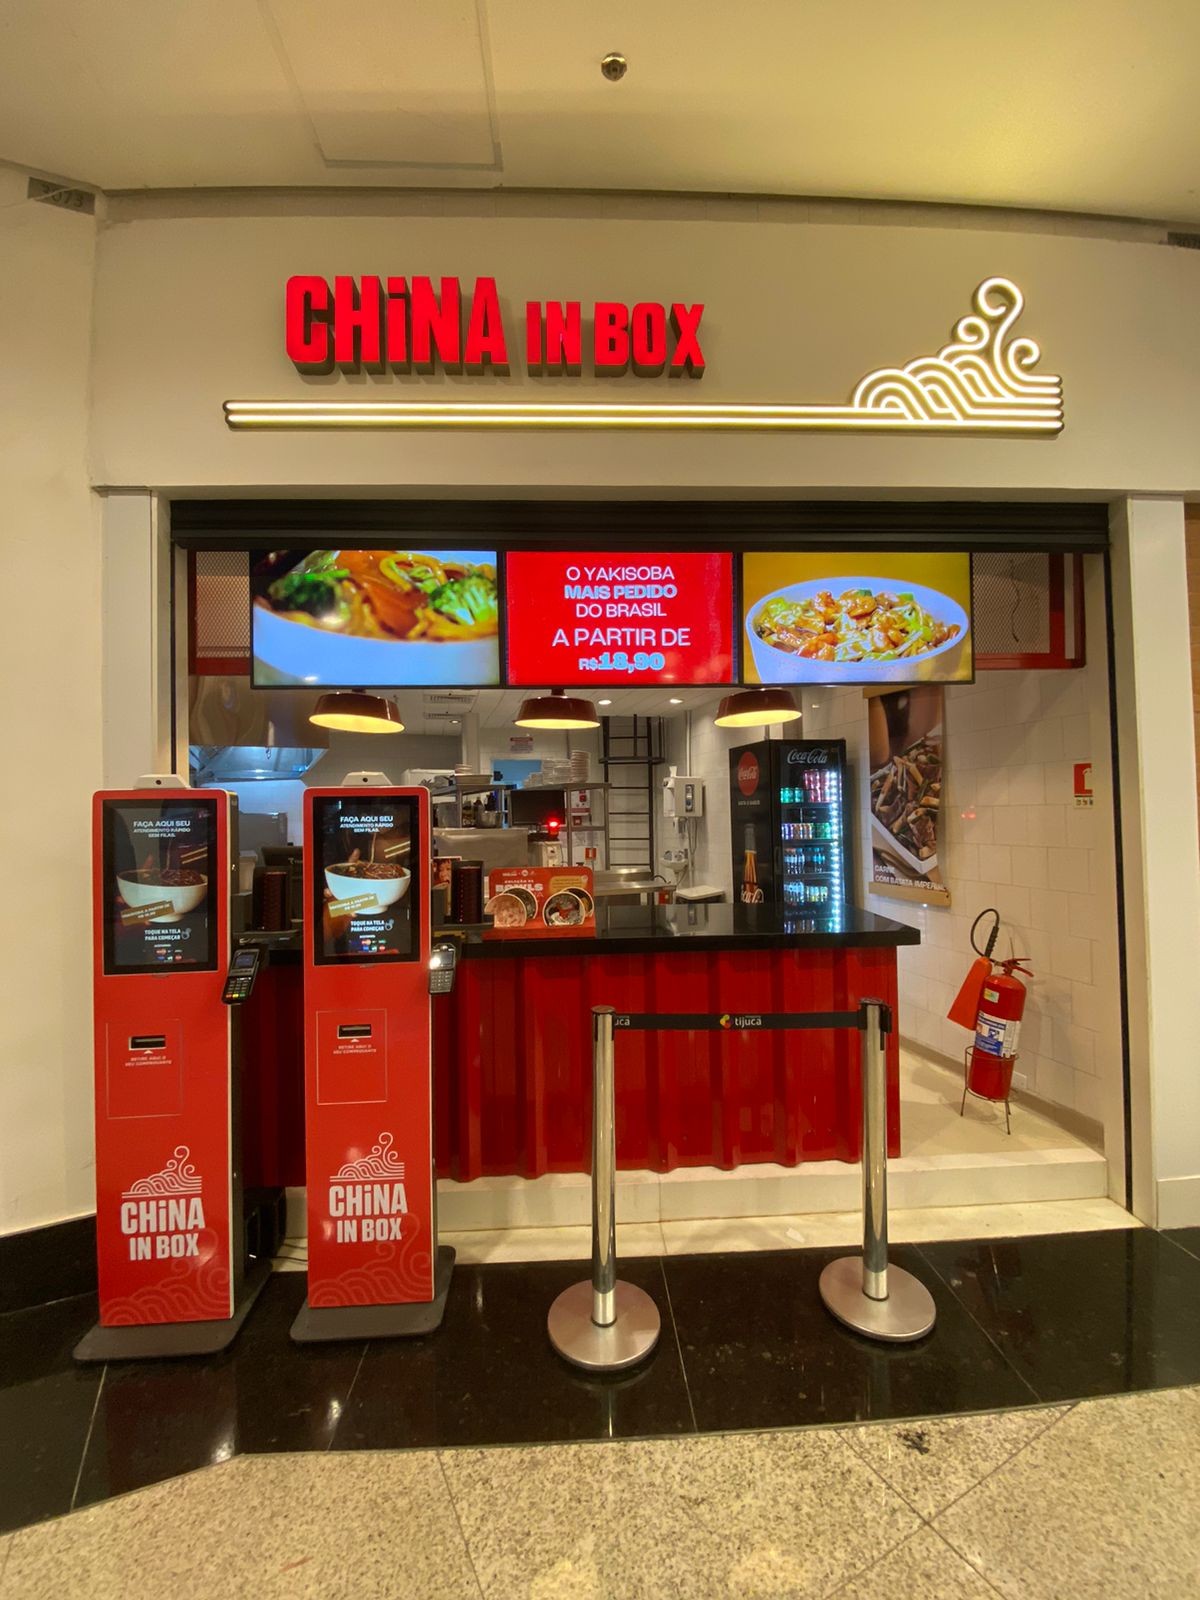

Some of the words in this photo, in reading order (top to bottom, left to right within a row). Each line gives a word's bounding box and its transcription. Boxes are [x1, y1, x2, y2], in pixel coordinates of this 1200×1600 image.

[286, 275, 510, 371] CHiNA
[526, 301, 581, 371] IN
[594, 302, 706, 373] BOX
[566, 566, 580, 581] O
[585, 566, 675, 581] YAKISOBA
[564, 585, 610, 599] MAIS
[613, 584, 678, 599] PEDIDO
[576, 604, 602, 618] DO
[606, 603, 667, 618] BRASIL
[552, 628, 569, 647] A
[574, 628, 655, 647] PARTIR
[661, 628, 691, 646] DE
[133, 820, 154, 828] FAÇA
[340, 815, 359, 823] FAÇA
[734, 1016, 762, 1028] tijuca
[329, 1183, 408, 1217] CHiNA
[121, 1197, 205, 1235] CHiNA
[337, 1219, 357, 1244] IN
[362, 1217, 403, 1242] BOX
[129, 1236, 151, 1261] IN
[156, 1232, 200, 1259] BOX
